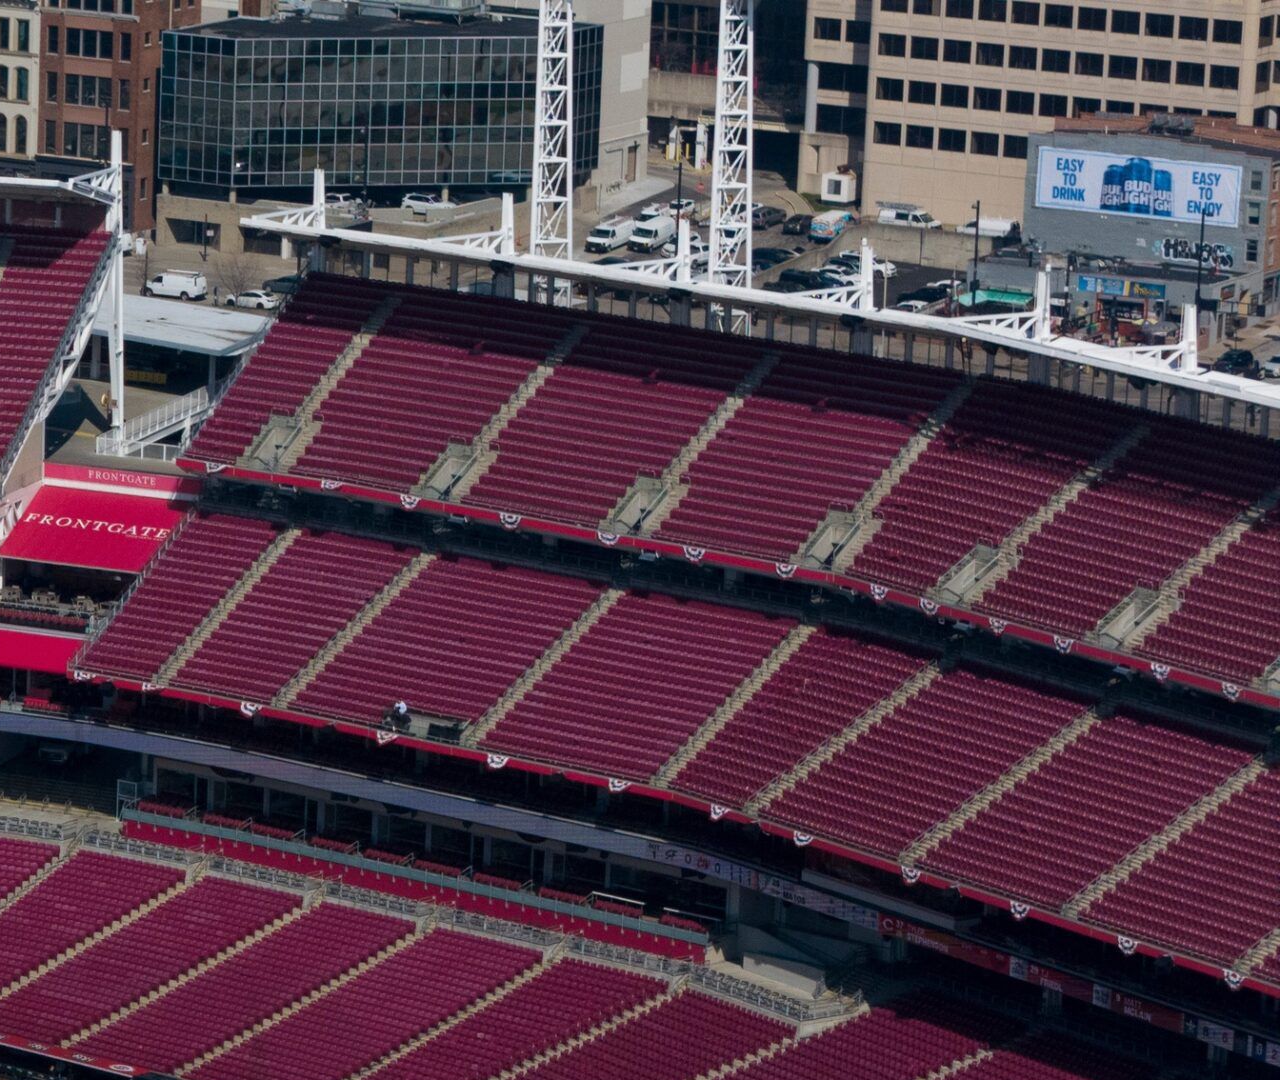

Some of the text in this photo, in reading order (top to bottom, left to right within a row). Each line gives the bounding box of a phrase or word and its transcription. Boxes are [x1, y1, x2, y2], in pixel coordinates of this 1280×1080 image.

[1056, 158, 1085, 172] EASY
[1062, 173, 1077, 187] TO
[1124, 180, 1151, 194] BUD
[1192, 171, 1222, 187] EASY
[1052, 186, 1086, 202] DRINK
[1198, 186, 1213, 201] TO
[1187, 200, 1223, 217] ENJOY
[88, 469, 157, 487] FRONTGATE
[24, 512, 171, 539] FRONTGATE
